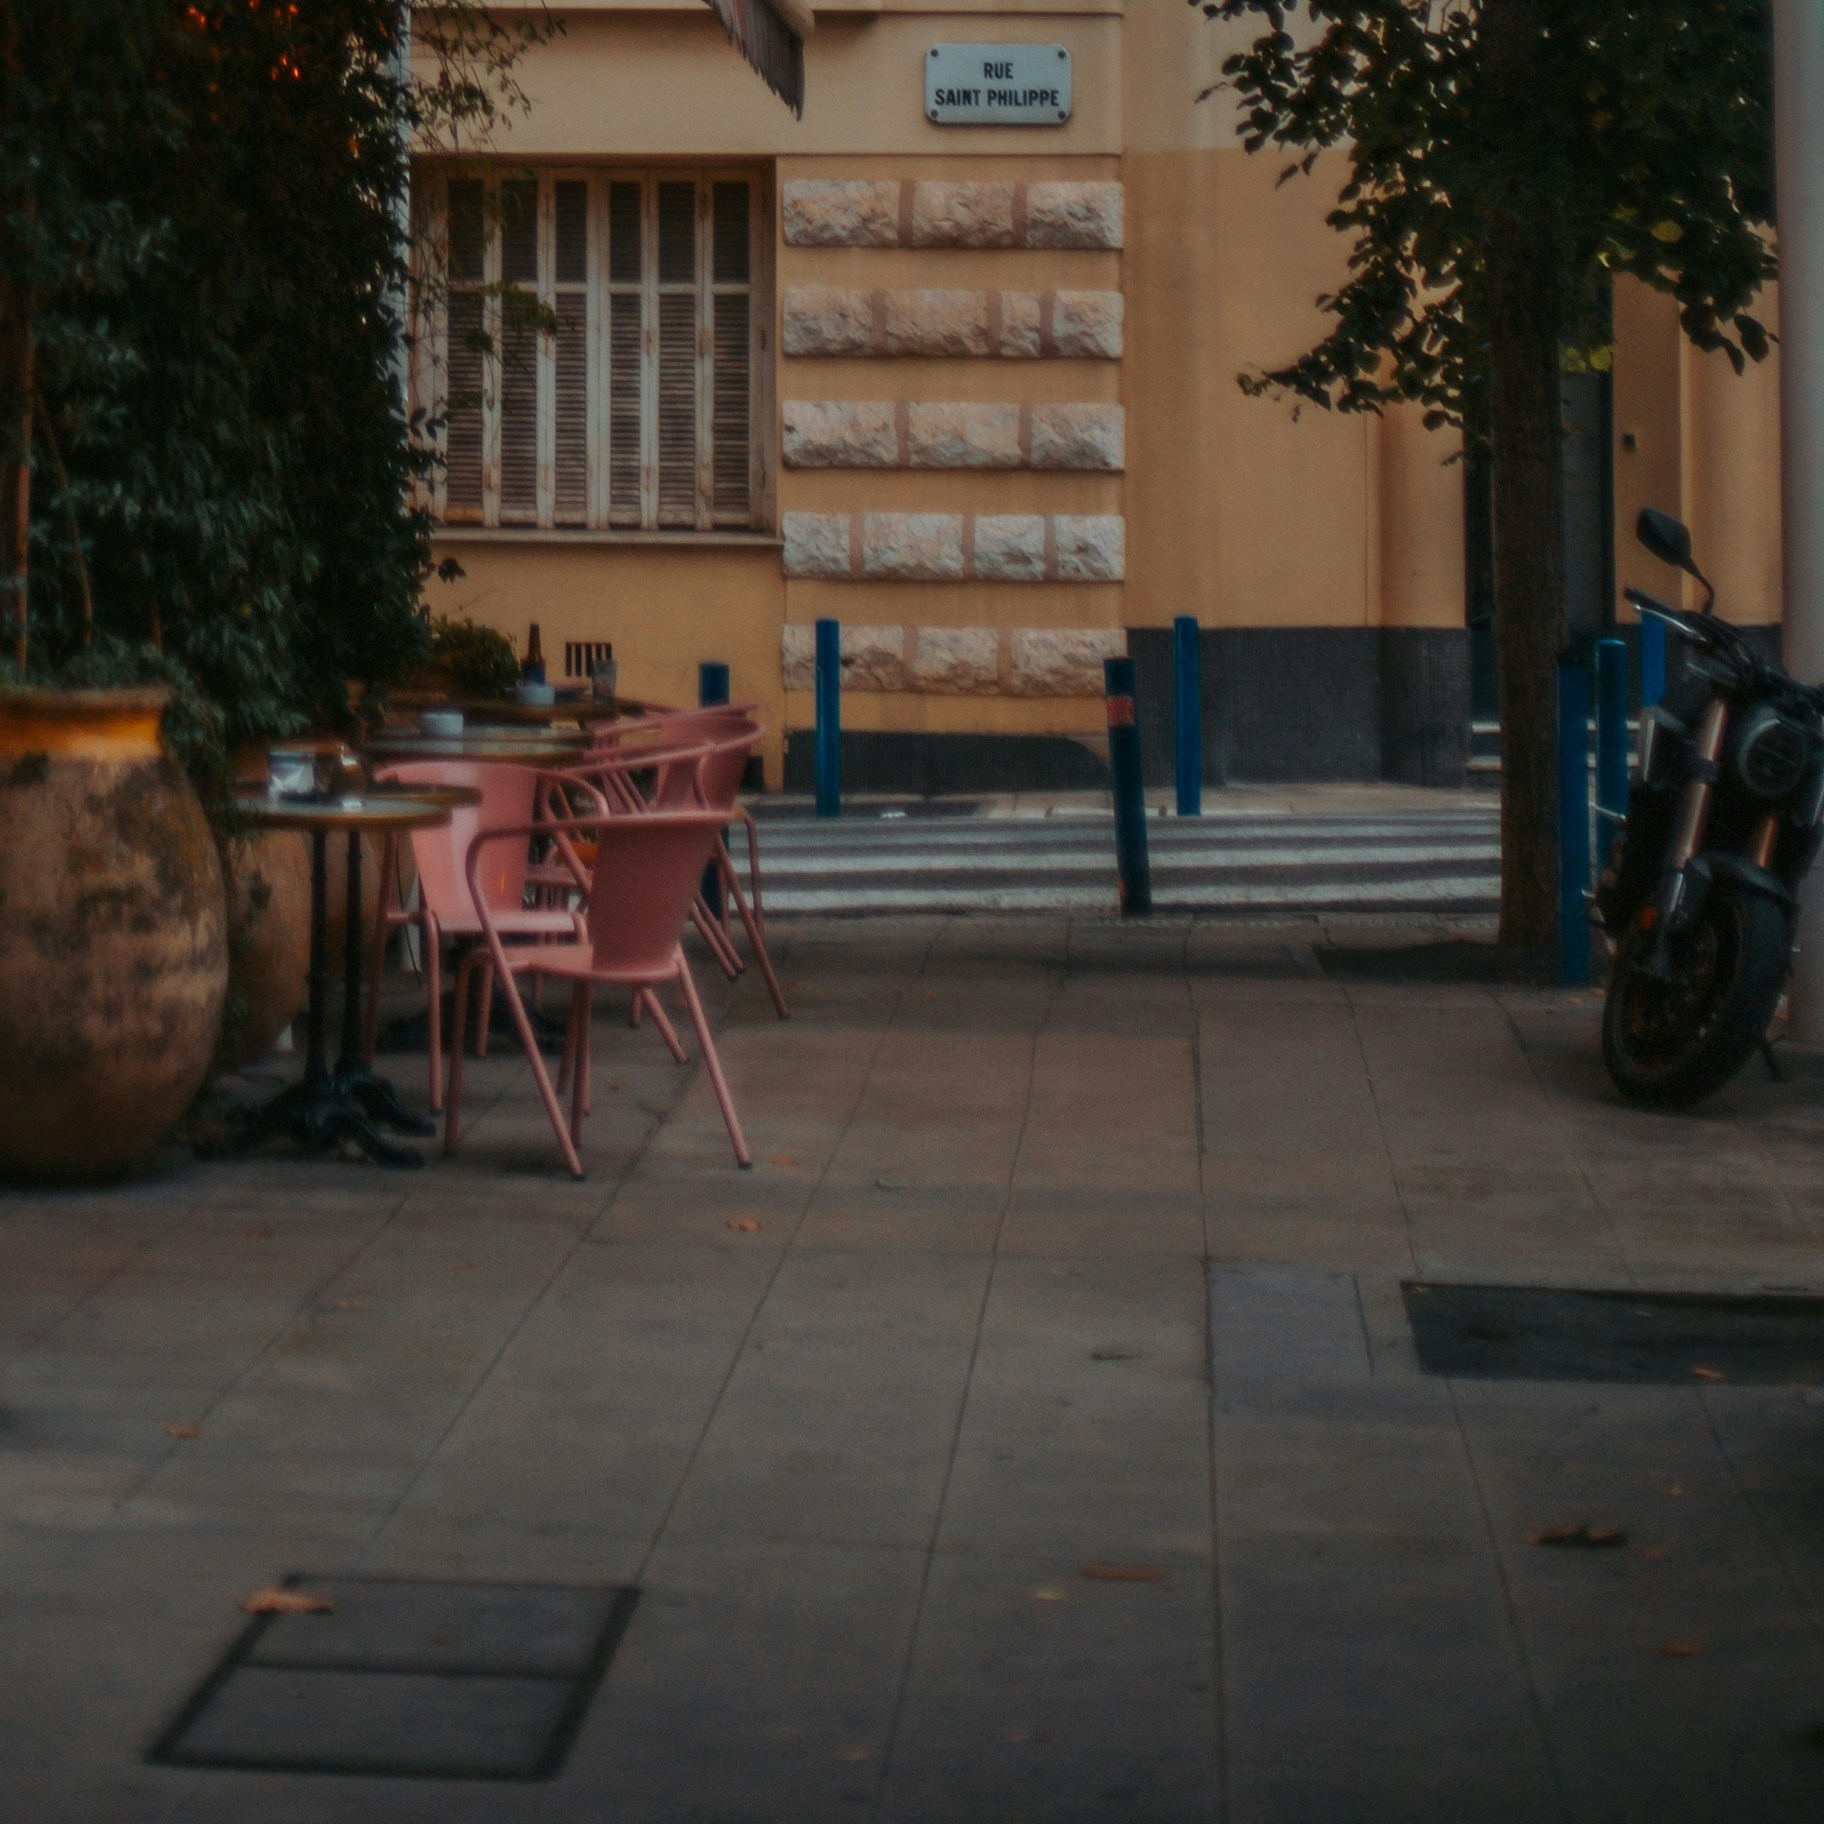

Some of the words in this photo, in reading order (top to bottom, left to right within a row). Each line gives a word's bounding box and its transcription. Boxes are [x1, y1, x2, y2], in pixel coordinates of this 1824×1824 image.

[983, 62, 1014, 79] RUE
[934, 88, 981, 107] SAINT
[987, 89, 1059, 107] PHILIPPE
